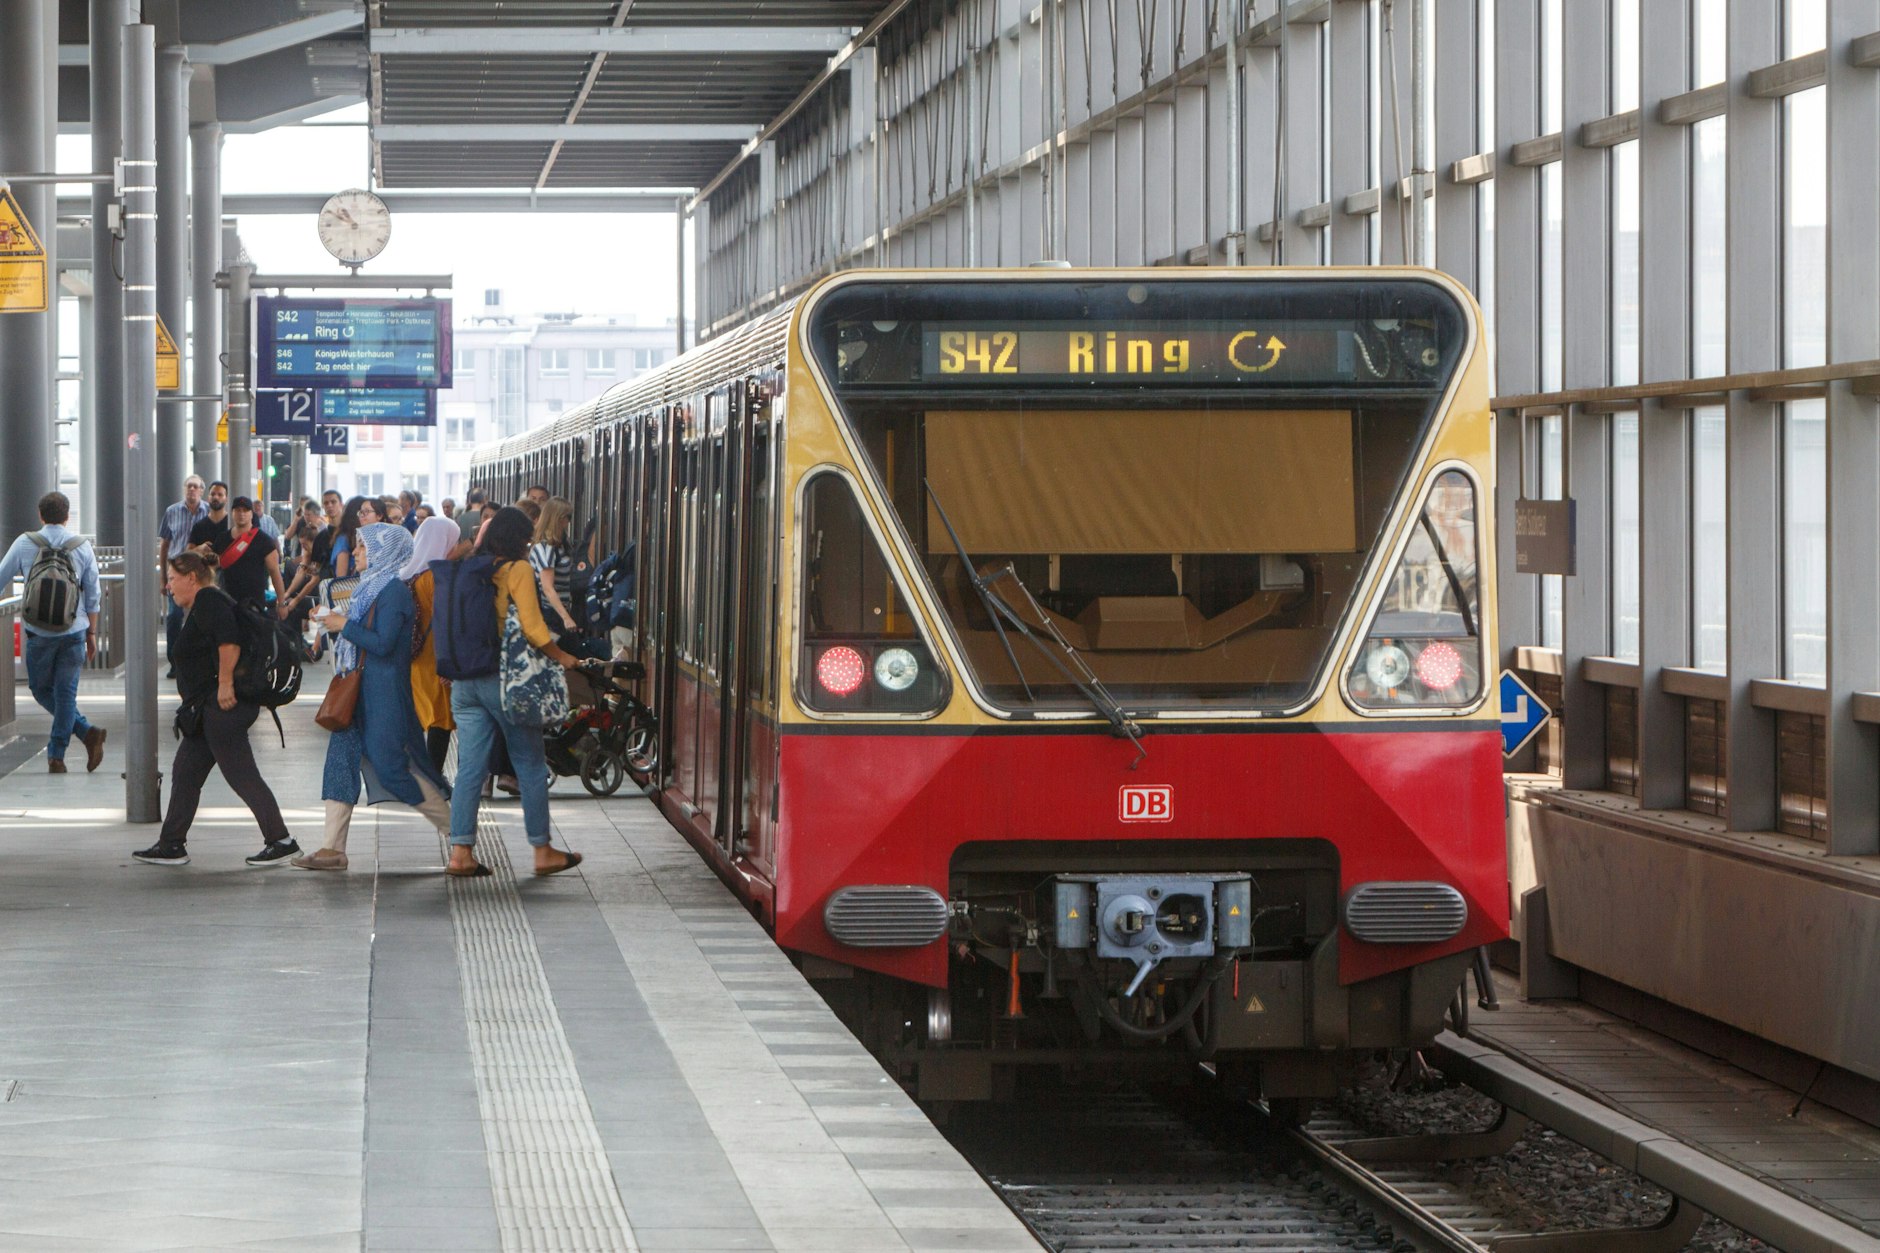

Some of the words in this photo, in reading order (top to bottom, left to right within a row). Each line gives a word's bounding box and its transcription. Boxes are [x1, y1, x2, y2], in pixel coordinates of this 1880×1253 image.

[277, 310, 298, 322] S42
[315, 326, 338, 340] Ring
[277, 349, 292, 358] S46
[940, 332, 1018, 373] S42
[1068, 332, 1190, 373] Ring
[277, 362, 292, 370] S42
[315, 362, 330, 372] Zug
[332, 362, 354, 370] endet
[278, 392, 310, 421] 12
[324, 427, 346, 446] 12
[1127, 792, 1166, 816] DB
